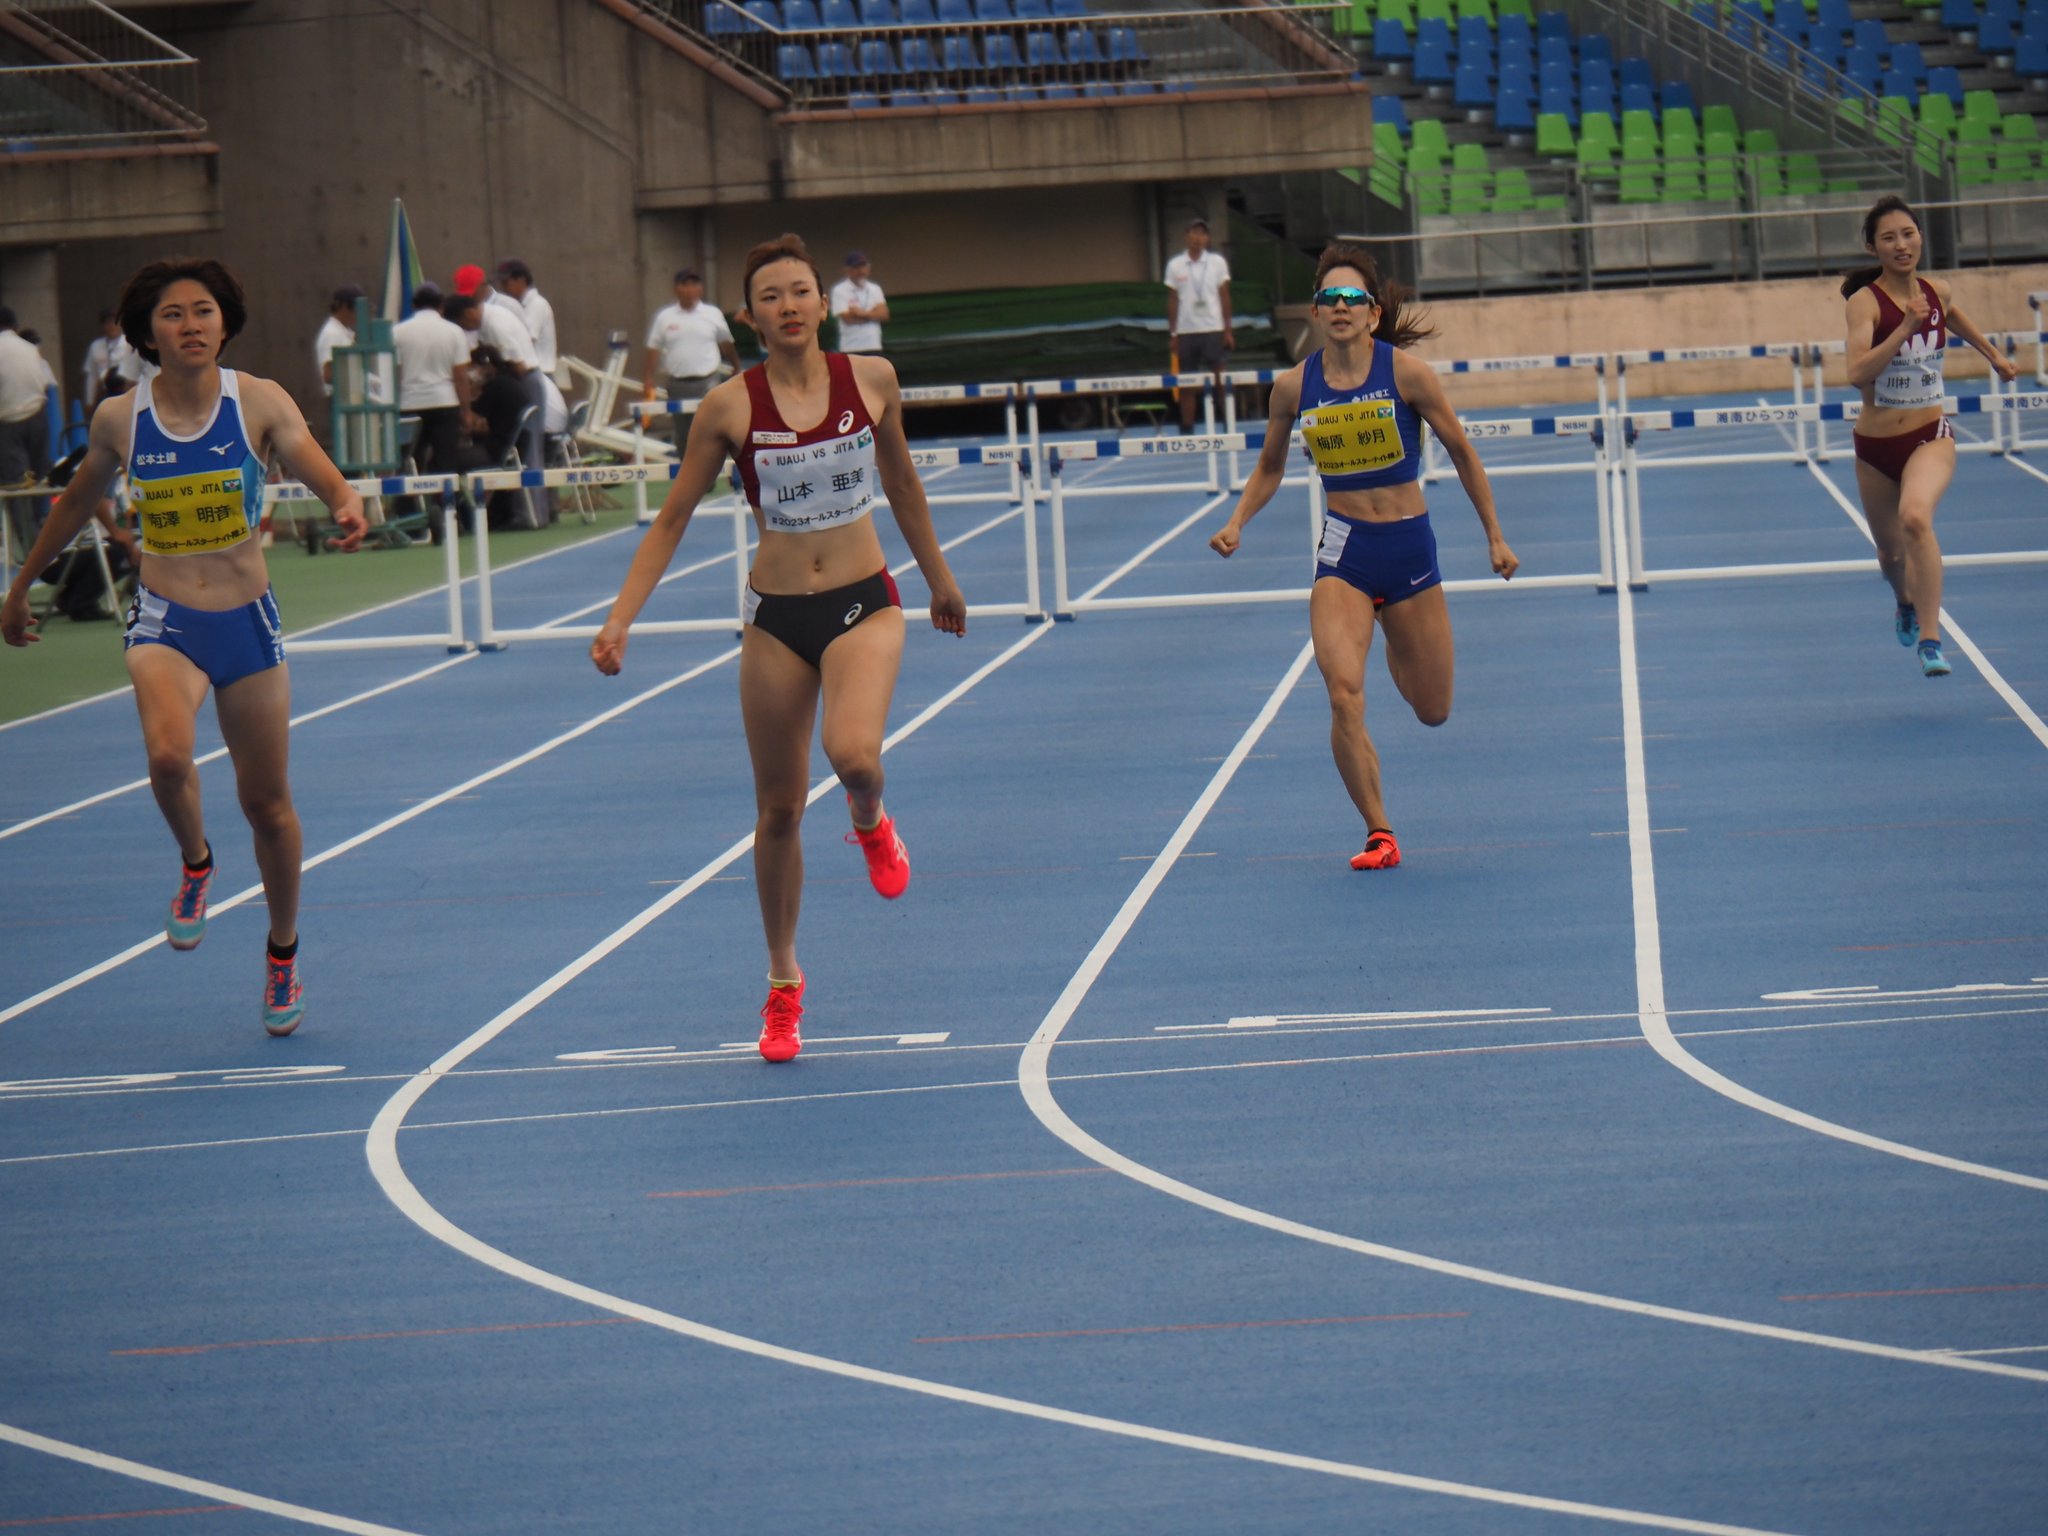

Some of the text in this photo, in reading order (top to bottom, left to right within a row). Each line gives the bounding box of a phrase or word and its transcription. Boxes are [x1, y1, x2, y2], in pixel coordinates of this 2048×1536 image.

[2002, 396, 2048, 409] 湘南ひ
[1318, 410, 1376, 426] IUAUJ VS JITA
[1716, 410, 1799, 424] 湘南ひらつか
[1562, 421, 1588, 430] NISHI
[1142, 438, 1224, 453] 湘南ひらつか
[1316, 434, 1346, 451] 梅原
[136, 451, 177, 465] 松本土建
[776, 441, 854, 466] IUAUJ VS JITA
[988, 451, 1014, 459] NISHI
[566, 470, 648, 484] 湘南ひらつか
[146, 483, 221, 501] IUAUJ VS JITA
[413, 482, 438, 490] NISHI
[777, 467, 864, 504] 山本 亜美
[196, 504, 232, 524] 明音
